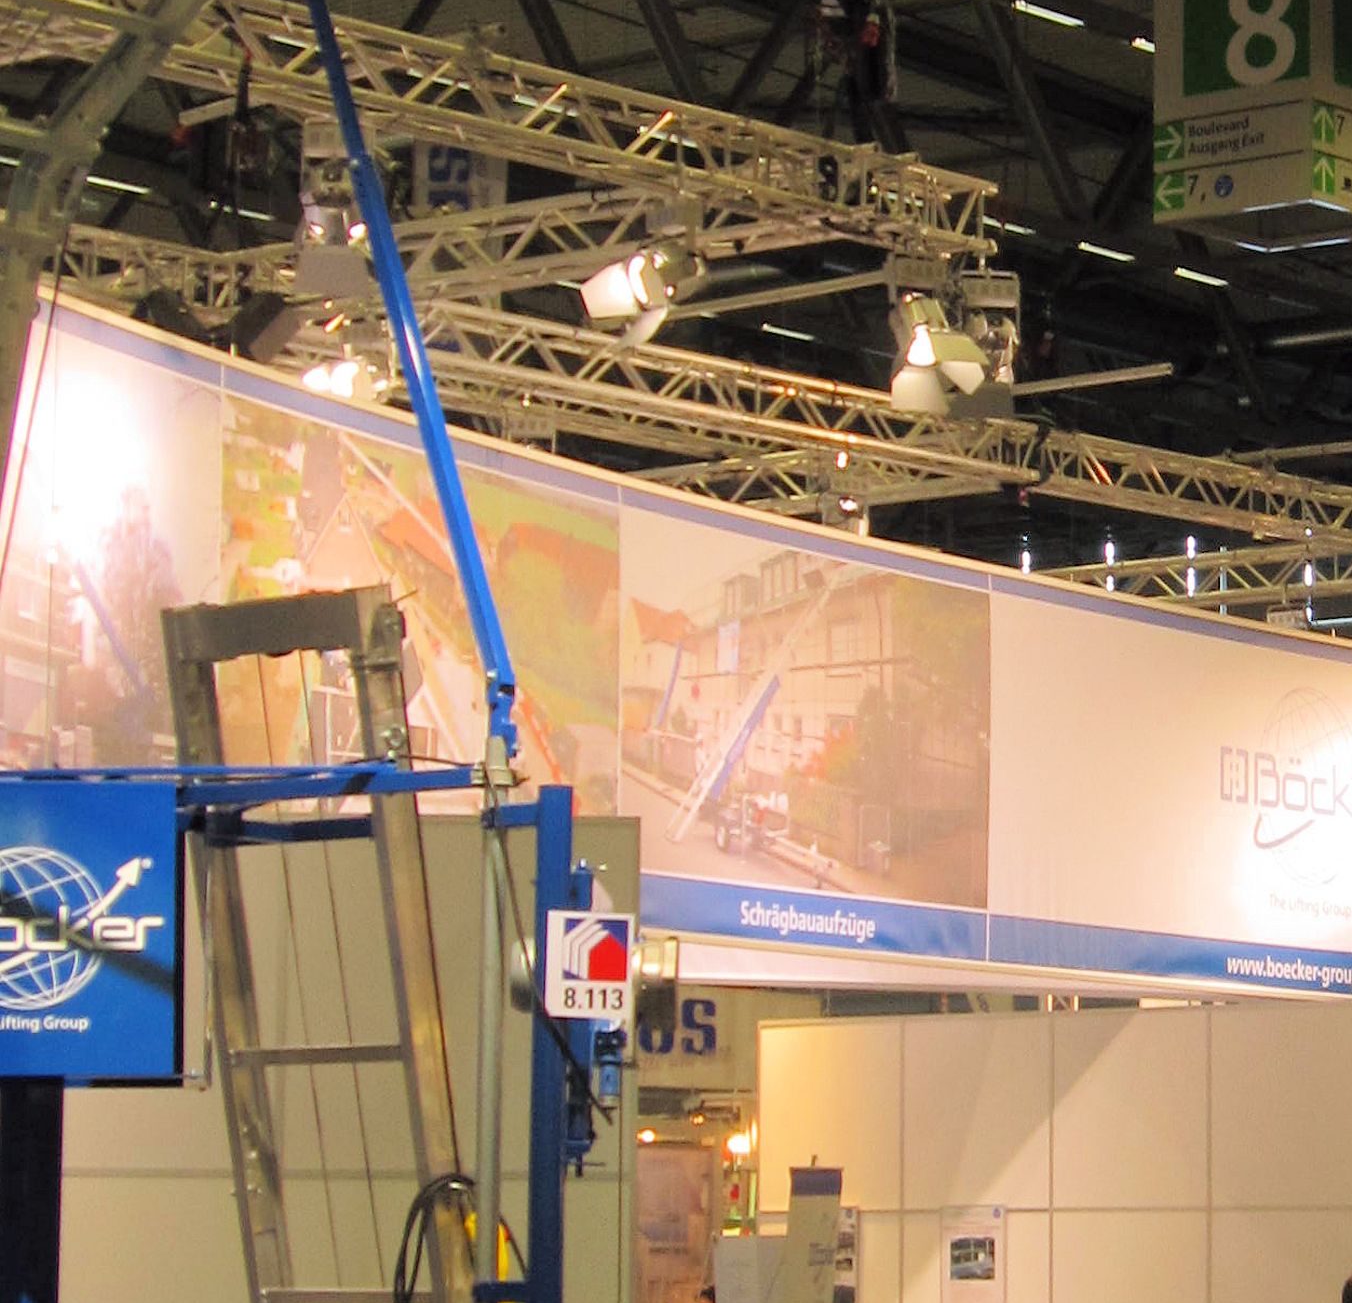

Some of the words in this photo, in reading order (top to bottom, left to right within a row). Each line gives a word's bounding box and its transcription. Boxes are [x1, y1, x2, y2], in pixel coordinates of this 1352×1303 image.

[1269, 894, 1287, 909] The
[740, 900, 876, 942] Schrägbauaufzüge
[564, 987, 624, 1011] 8.113
[43, 1015, 90, 1034] Group
